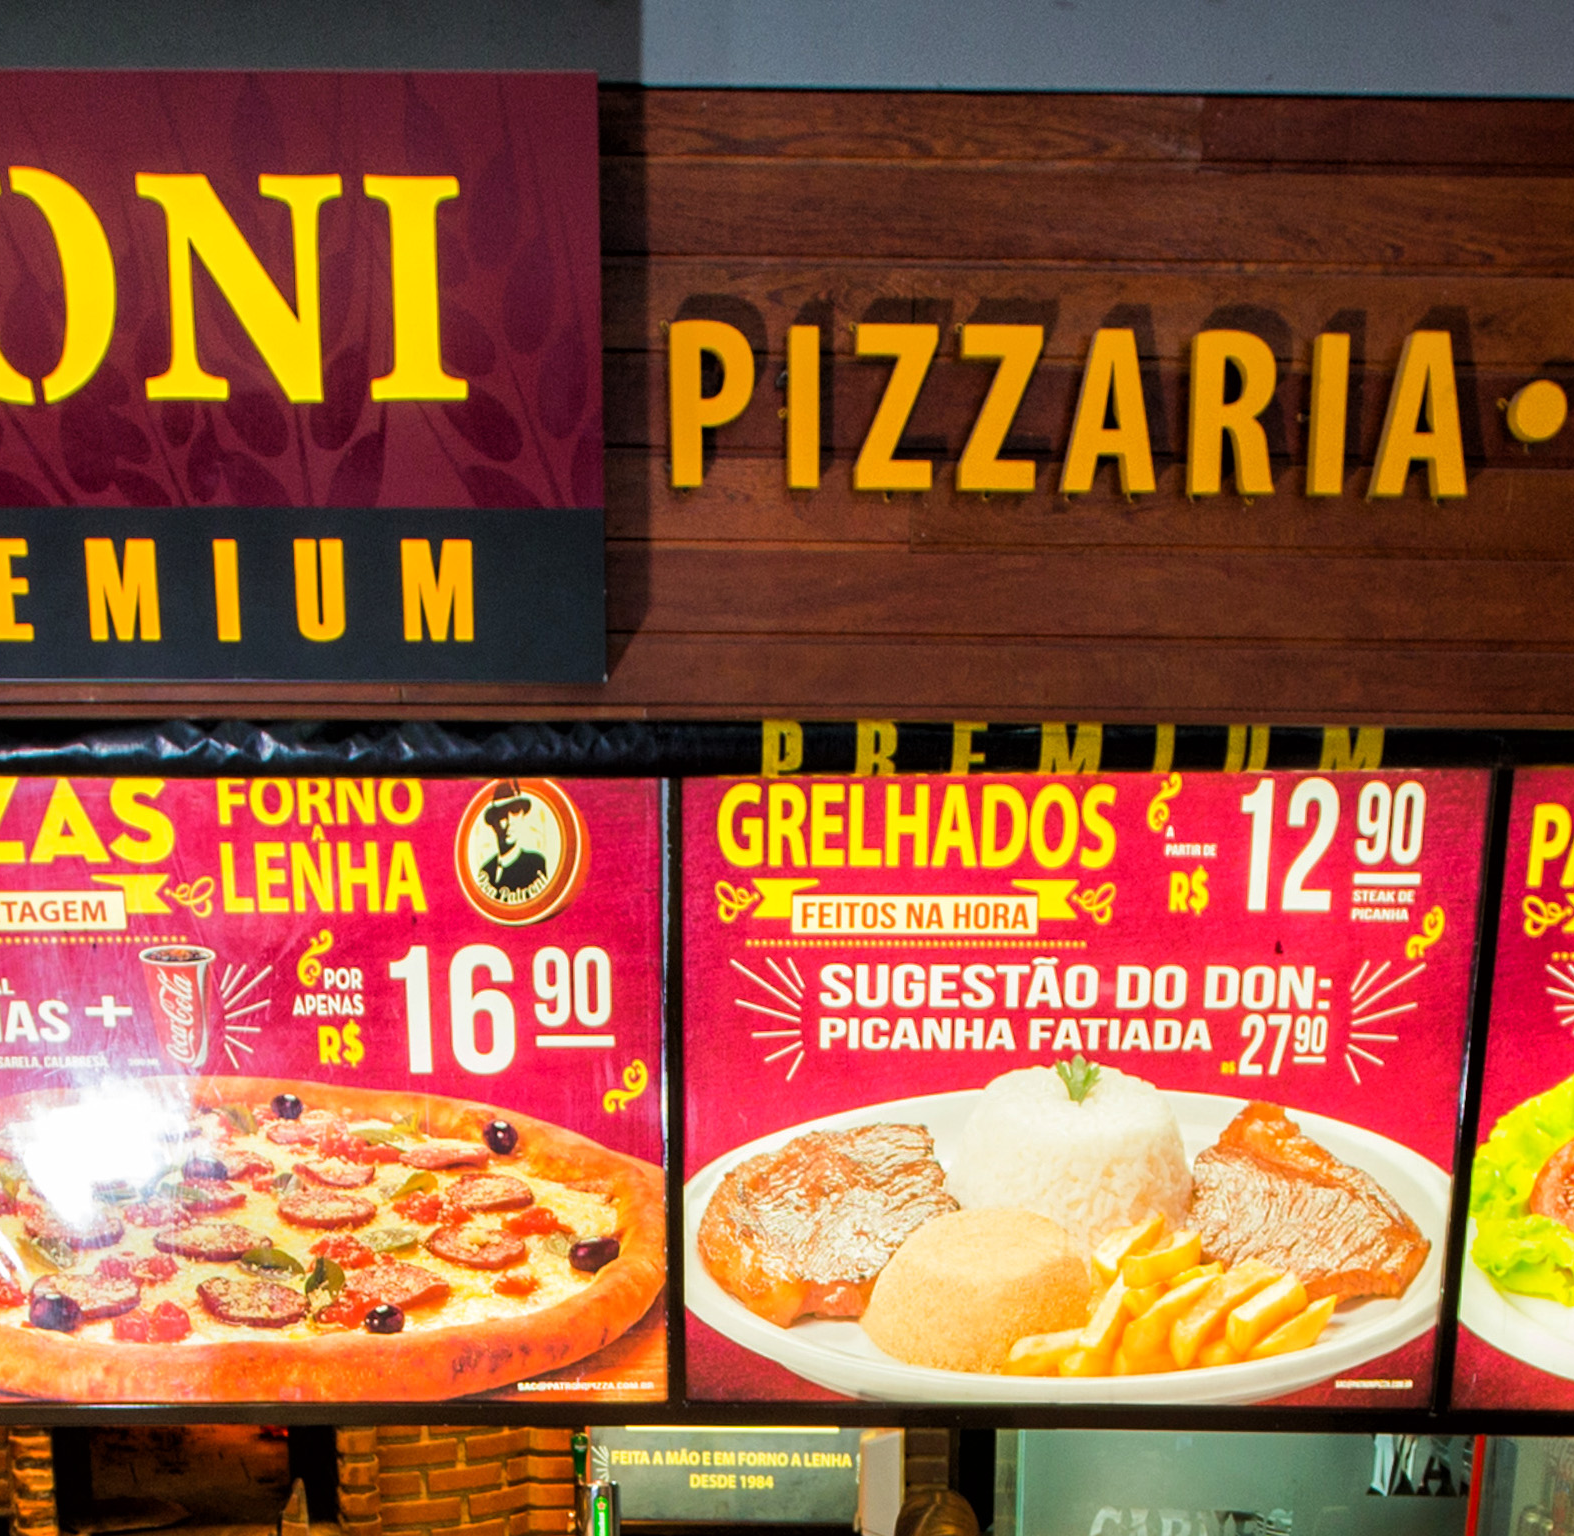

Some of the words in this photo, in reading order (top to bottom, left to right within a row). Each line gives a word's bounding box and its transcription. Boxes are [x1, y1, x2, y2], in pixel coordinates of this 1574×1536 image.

[665, 318, 1468, 503] PIZZARIA
[216, 779, 424, 826] FORNO
[716, 782, 1118, 869] GRELHADOS
[1165, 825, 1175, 838] A
[1164, 844, 1202, 858] PARTIR
[1202, 844, 1218, 858] DE
[1168, 865, 1210, 916] R$
[1240, 776, 1341, 912] 12
[1354, 779, 1427, 866] 90
[218, 841, 429, 914] LENHA
[476, 870, 498, 899] Don
[498, 871, 549, 905] Patroni
[1352, 889, 1395, 904] STEAK
[1396, 889, 1416, 904] DE
[800, 902, 897, 930] FEITOS
[905, 902, 945, 930] NA
[953, 902, 1030, 930] HORA
[1351, 907, 1410, 921] PICANHA
[323, 967, 363, 990] POR
[818, 956, 1100, 1010] SUGESTÃO
[1114, 964, 1189, 1010] DO
[1203, 965, 1332, 1010] DON:
[292, 993, 365, 1017] APENAS
[317, 1019, 365, 1069] R$
[387, 943, 517, 1077] 16
[531, 946, 612, 1028] 90
[818, 1016, 1016, 1051] PICANHA
[1027, 1017, 1213, 1052] FATIADA
[1237, 1013, 1292, 1077] 27
[1293, 1014, 1329, 1054] 90
[610, 1449, 651, 1466] FEITA
[652, 1450, 664, 1466] A
[665, 1447, 701, 1466] MÃO
[702, 1450, 712, 1466] E
[713, 1450, 736, 1466] EM
[738, 1450, 789, 1467] FORNO
[791, 1452, 802, 1468] A
[803, 1452, 852, 1468] LENHA
[689, 1473, 737, 1489] DESDE
[739, 1474, 774, 1490] 1984
